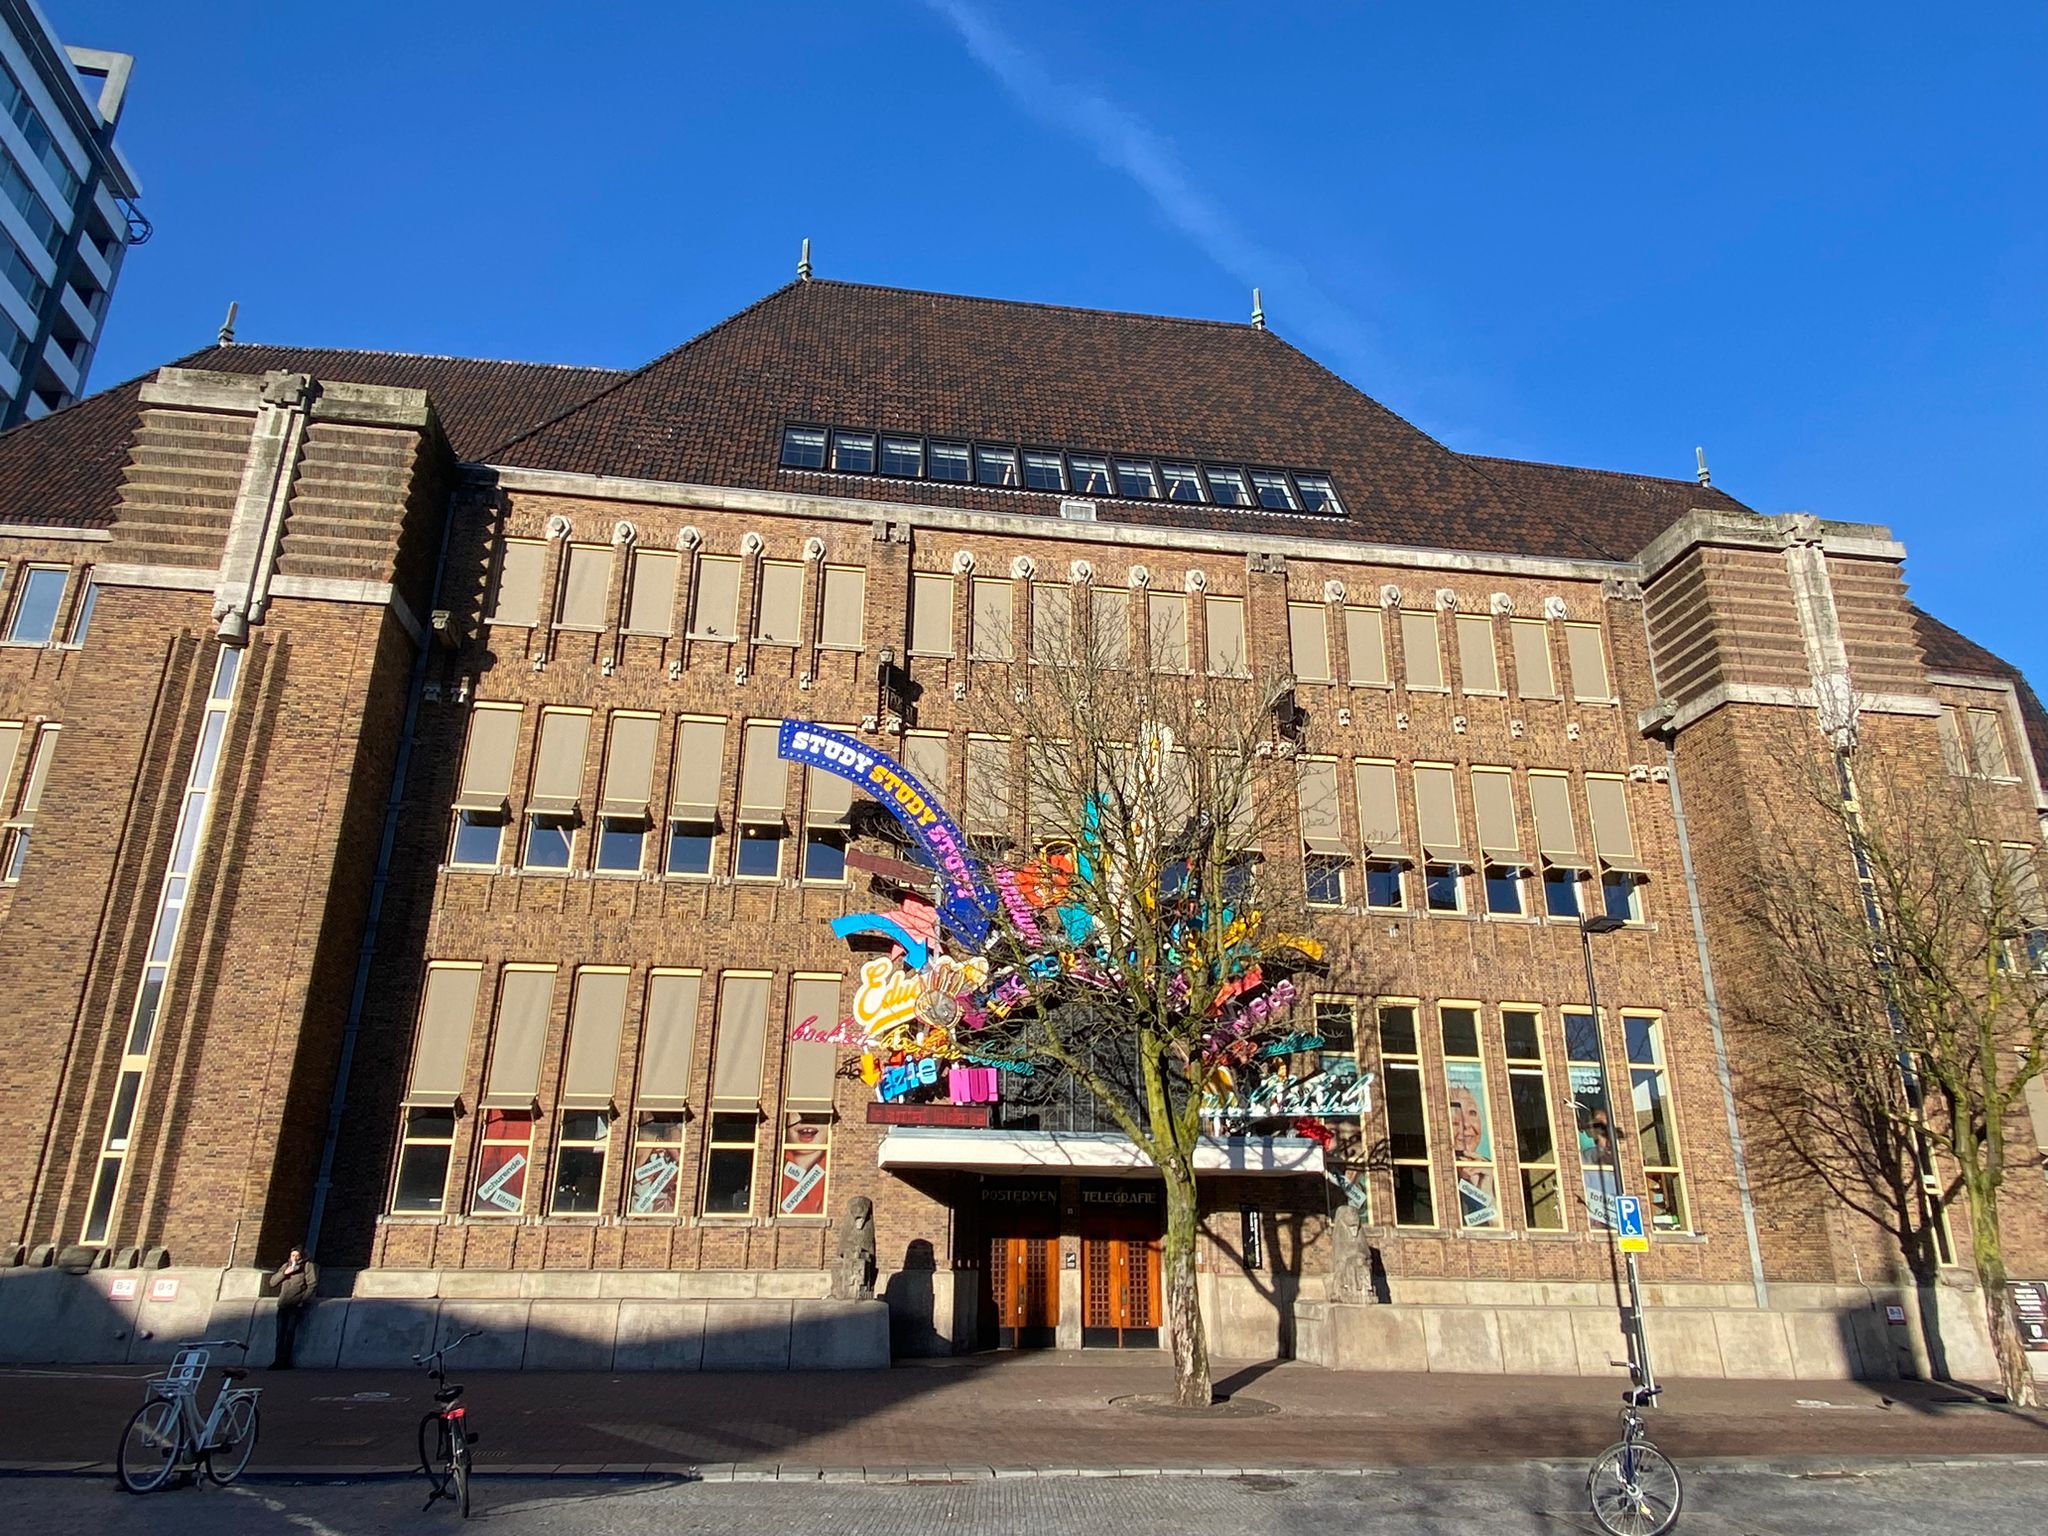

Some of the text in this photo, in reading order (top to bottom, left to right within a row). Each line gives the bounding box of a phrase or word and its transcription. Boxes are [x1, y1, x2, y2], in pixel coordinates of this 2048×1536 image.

[791, 731, 874, 774] STUDY
[869, 764, 937, 827] STUDY
[949, 1067, 999, 1102] NU!
[483, 1160, 521, 1195] schurende
[638, 1162, 663, 1177] nieuwe
[787, 1166, 801, 1178] lab
[785, 1169, 821, 1209] experiment
[1590, 1191, 1615, 1207] totle
[496, 1194, 515, 1209] films
[1620, 1199, 1635, 1221] P
